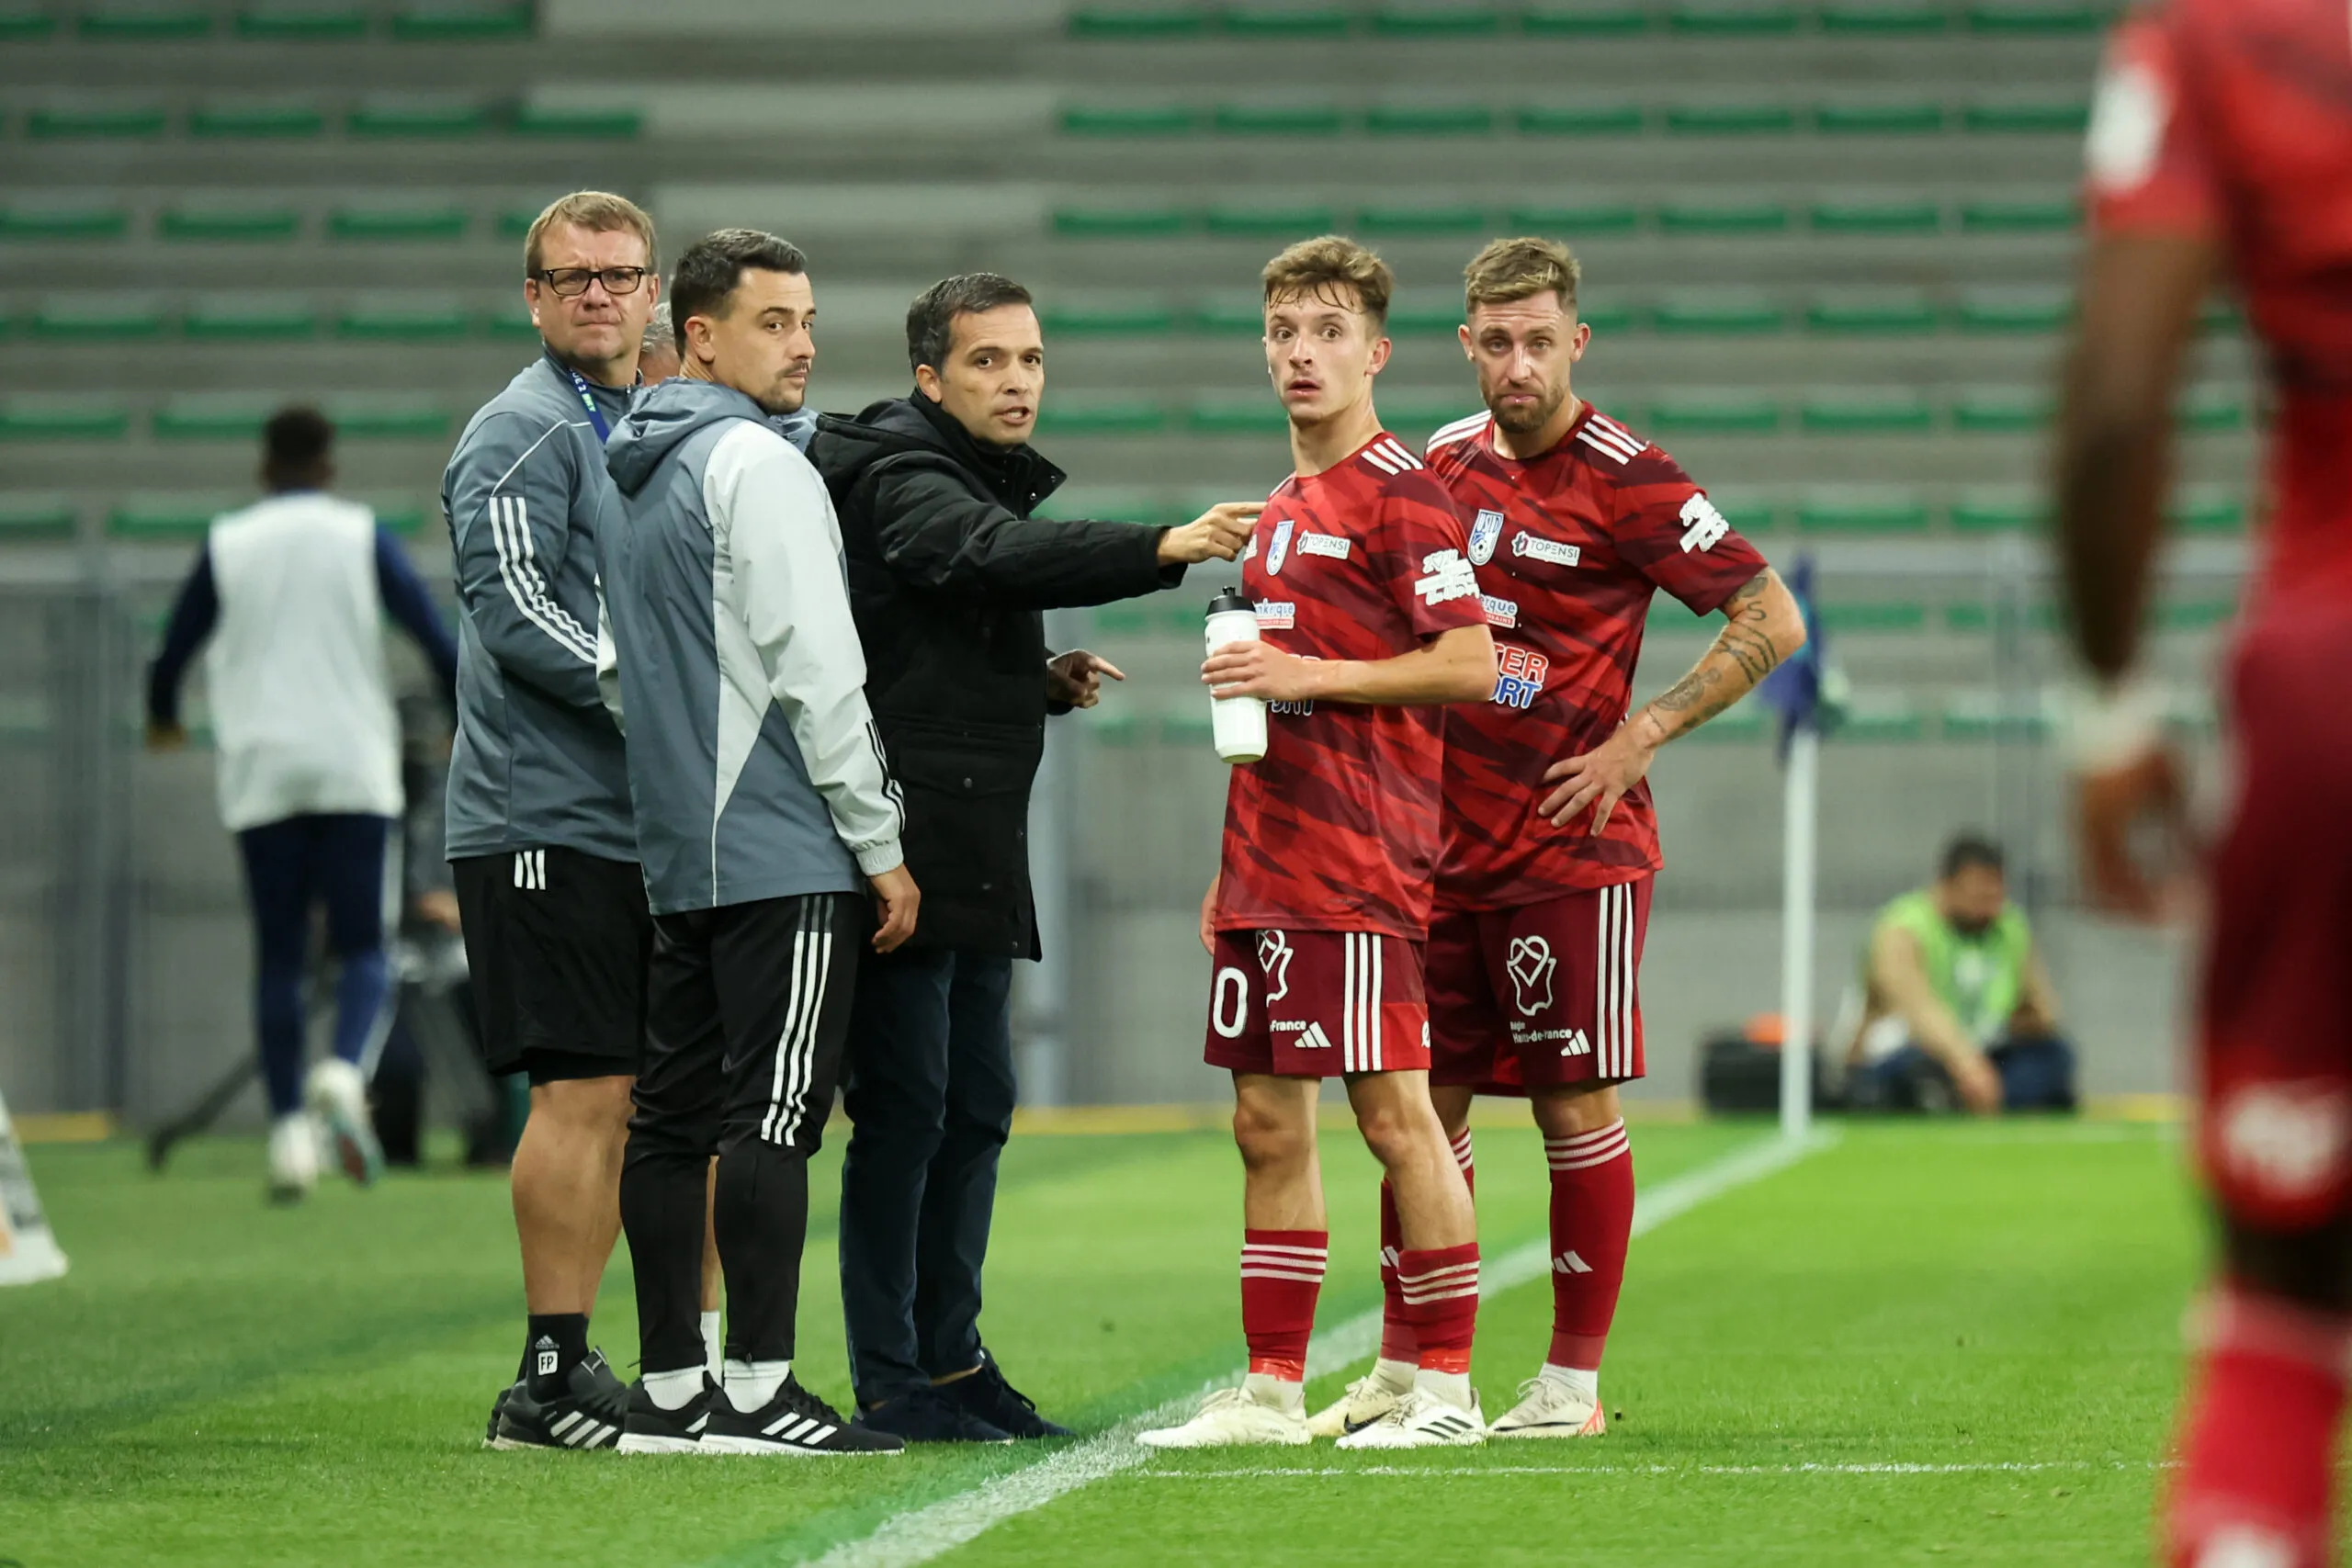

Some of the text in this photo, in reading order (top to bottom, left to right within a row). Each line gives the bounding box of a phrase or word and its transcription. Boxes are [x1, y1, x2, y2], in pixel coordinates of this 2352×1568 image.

[578, 384, 587, 392] 2
[1531, 539, 1578, 558] TOPENSI
[1213, 966, 1248, 1038] 0
[1270, 1020, 1306, 1032] France
[540, 1355, 554, 1371] FP
